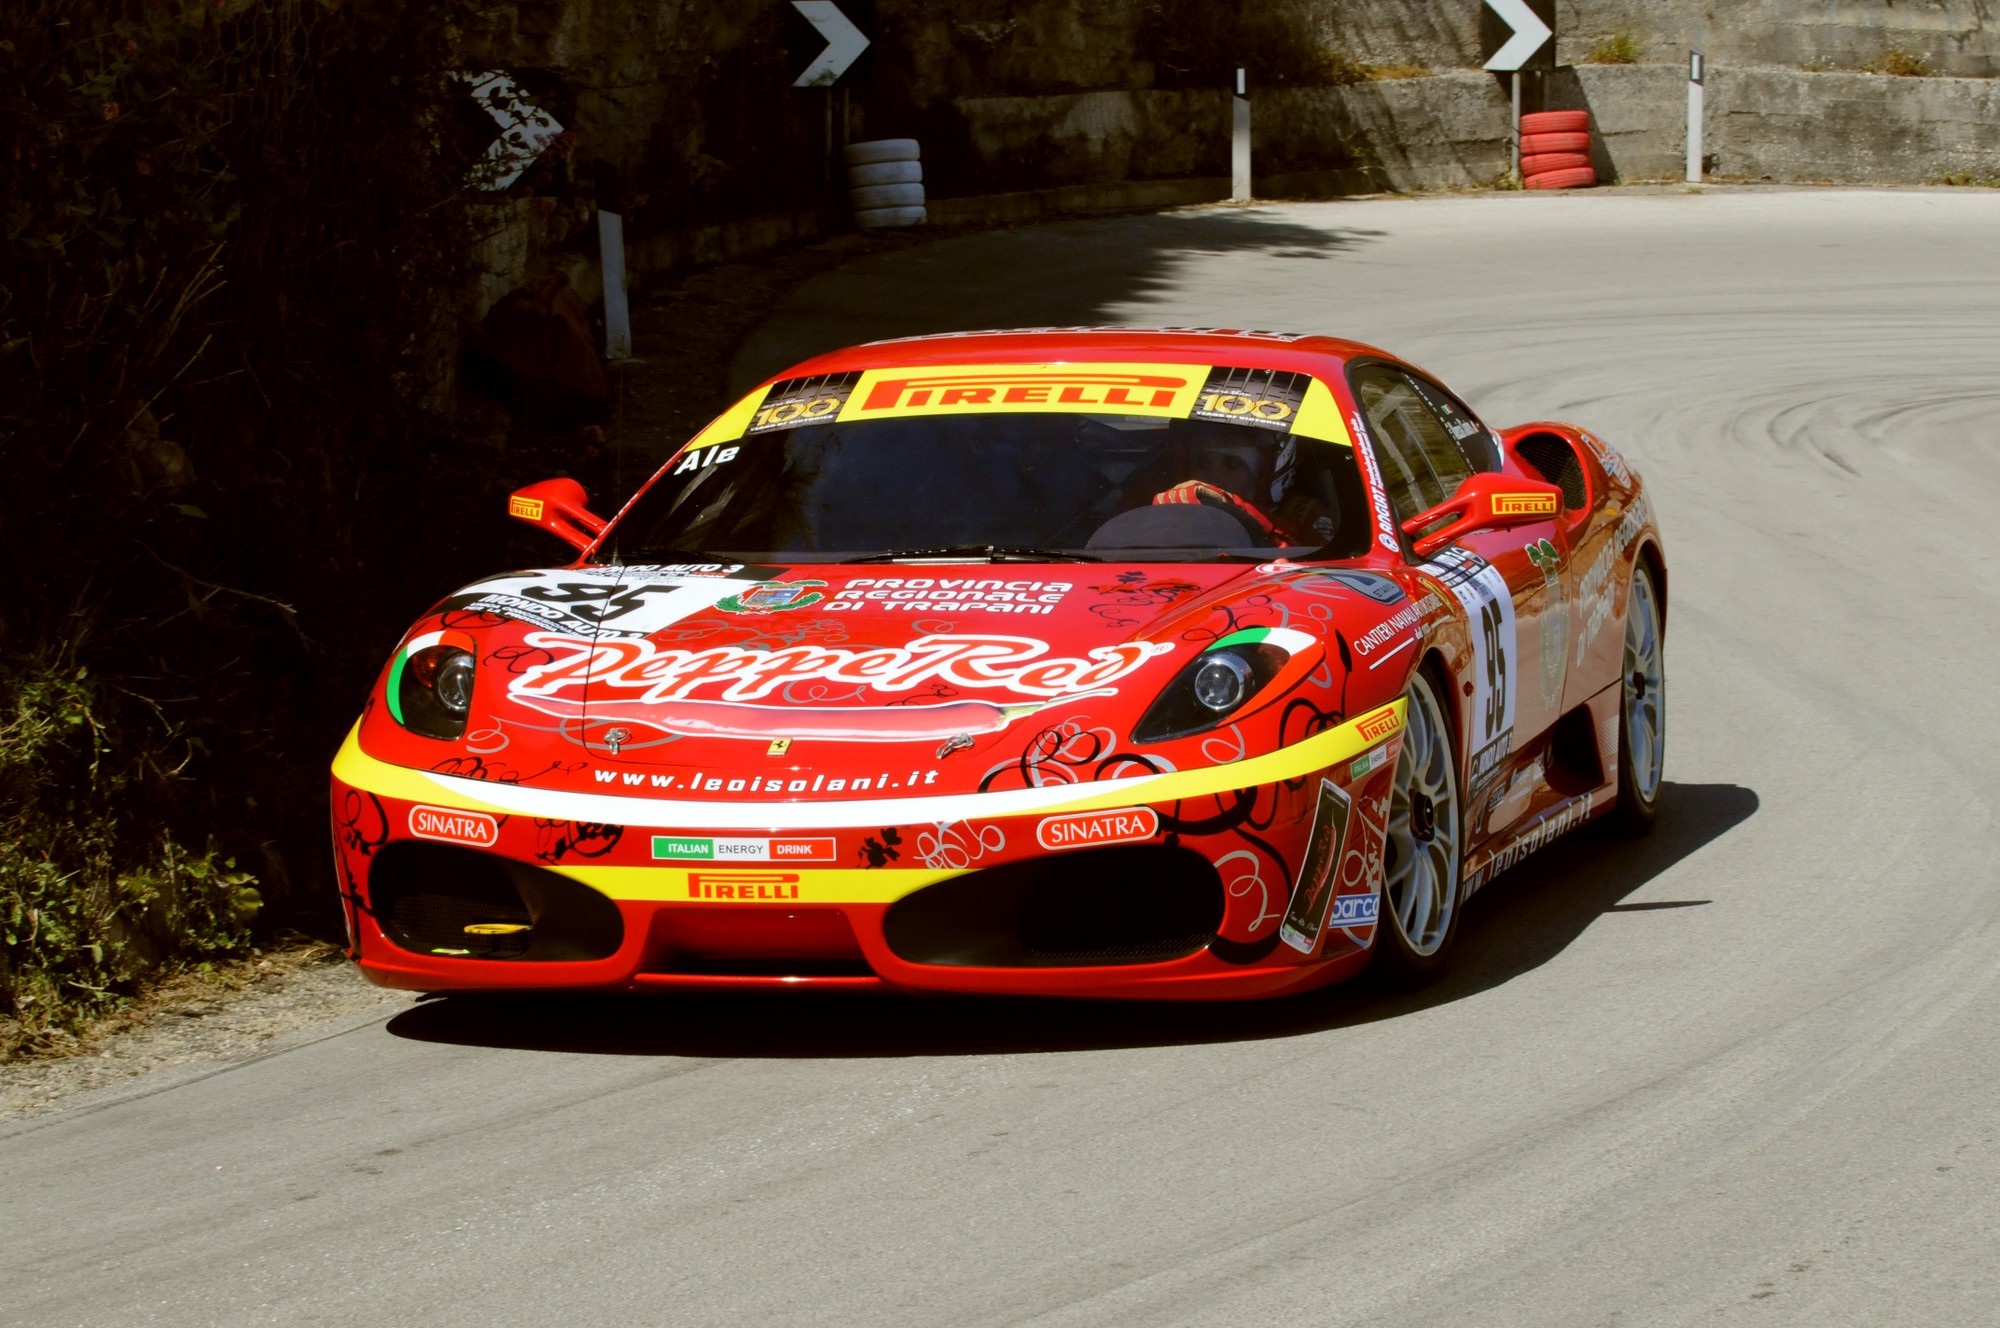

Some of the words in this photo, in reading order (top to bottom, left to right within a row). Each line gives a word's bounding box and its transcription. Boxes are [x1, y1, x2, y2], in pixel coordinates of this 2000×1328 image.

[861, 373, 1187, 411] PIRELLI
[755, 397, 842, 427] 100
[1195, 410, 1226, 418] YEARS
[1239, 415, 1288, 427] VICTORIES
[1200, 394, 1293, 421] 100
[673, 444, 741, 476] Ale
[510, 498, 541, 518] PIRELLI
[1494, 495, 1556, 513] PIRELLI
[660, 563, 722, 573] AUTO
[722, 563, 745, 574] 3
[834, 590, 1065, 603] REGIONALE
[844, 578, 1074, 593] PROVINCIA
[478, 593, 565, 620] MONDO
[822, 600, 865, 611] DI
[880, 600, 1055, 615] TRAPANI
[1353, 619, 1396, 656] CANTIERI
[1355, 706, 1400, 742] PIRELLI
[594, 769, 939, 793] www.leoisolani.it
[418, 812, 487, 840] SINATRA
[1050, 815, 1146, 843] SINATRA
[668, 842, 709, 855] ITALIAN
[718, 843, 764, 855] ENERGY
[776, 843, 813, 856] DRINK
[687, 872, 800, 899] PIRELLI
[1331, 897, 1380, 922] parco
